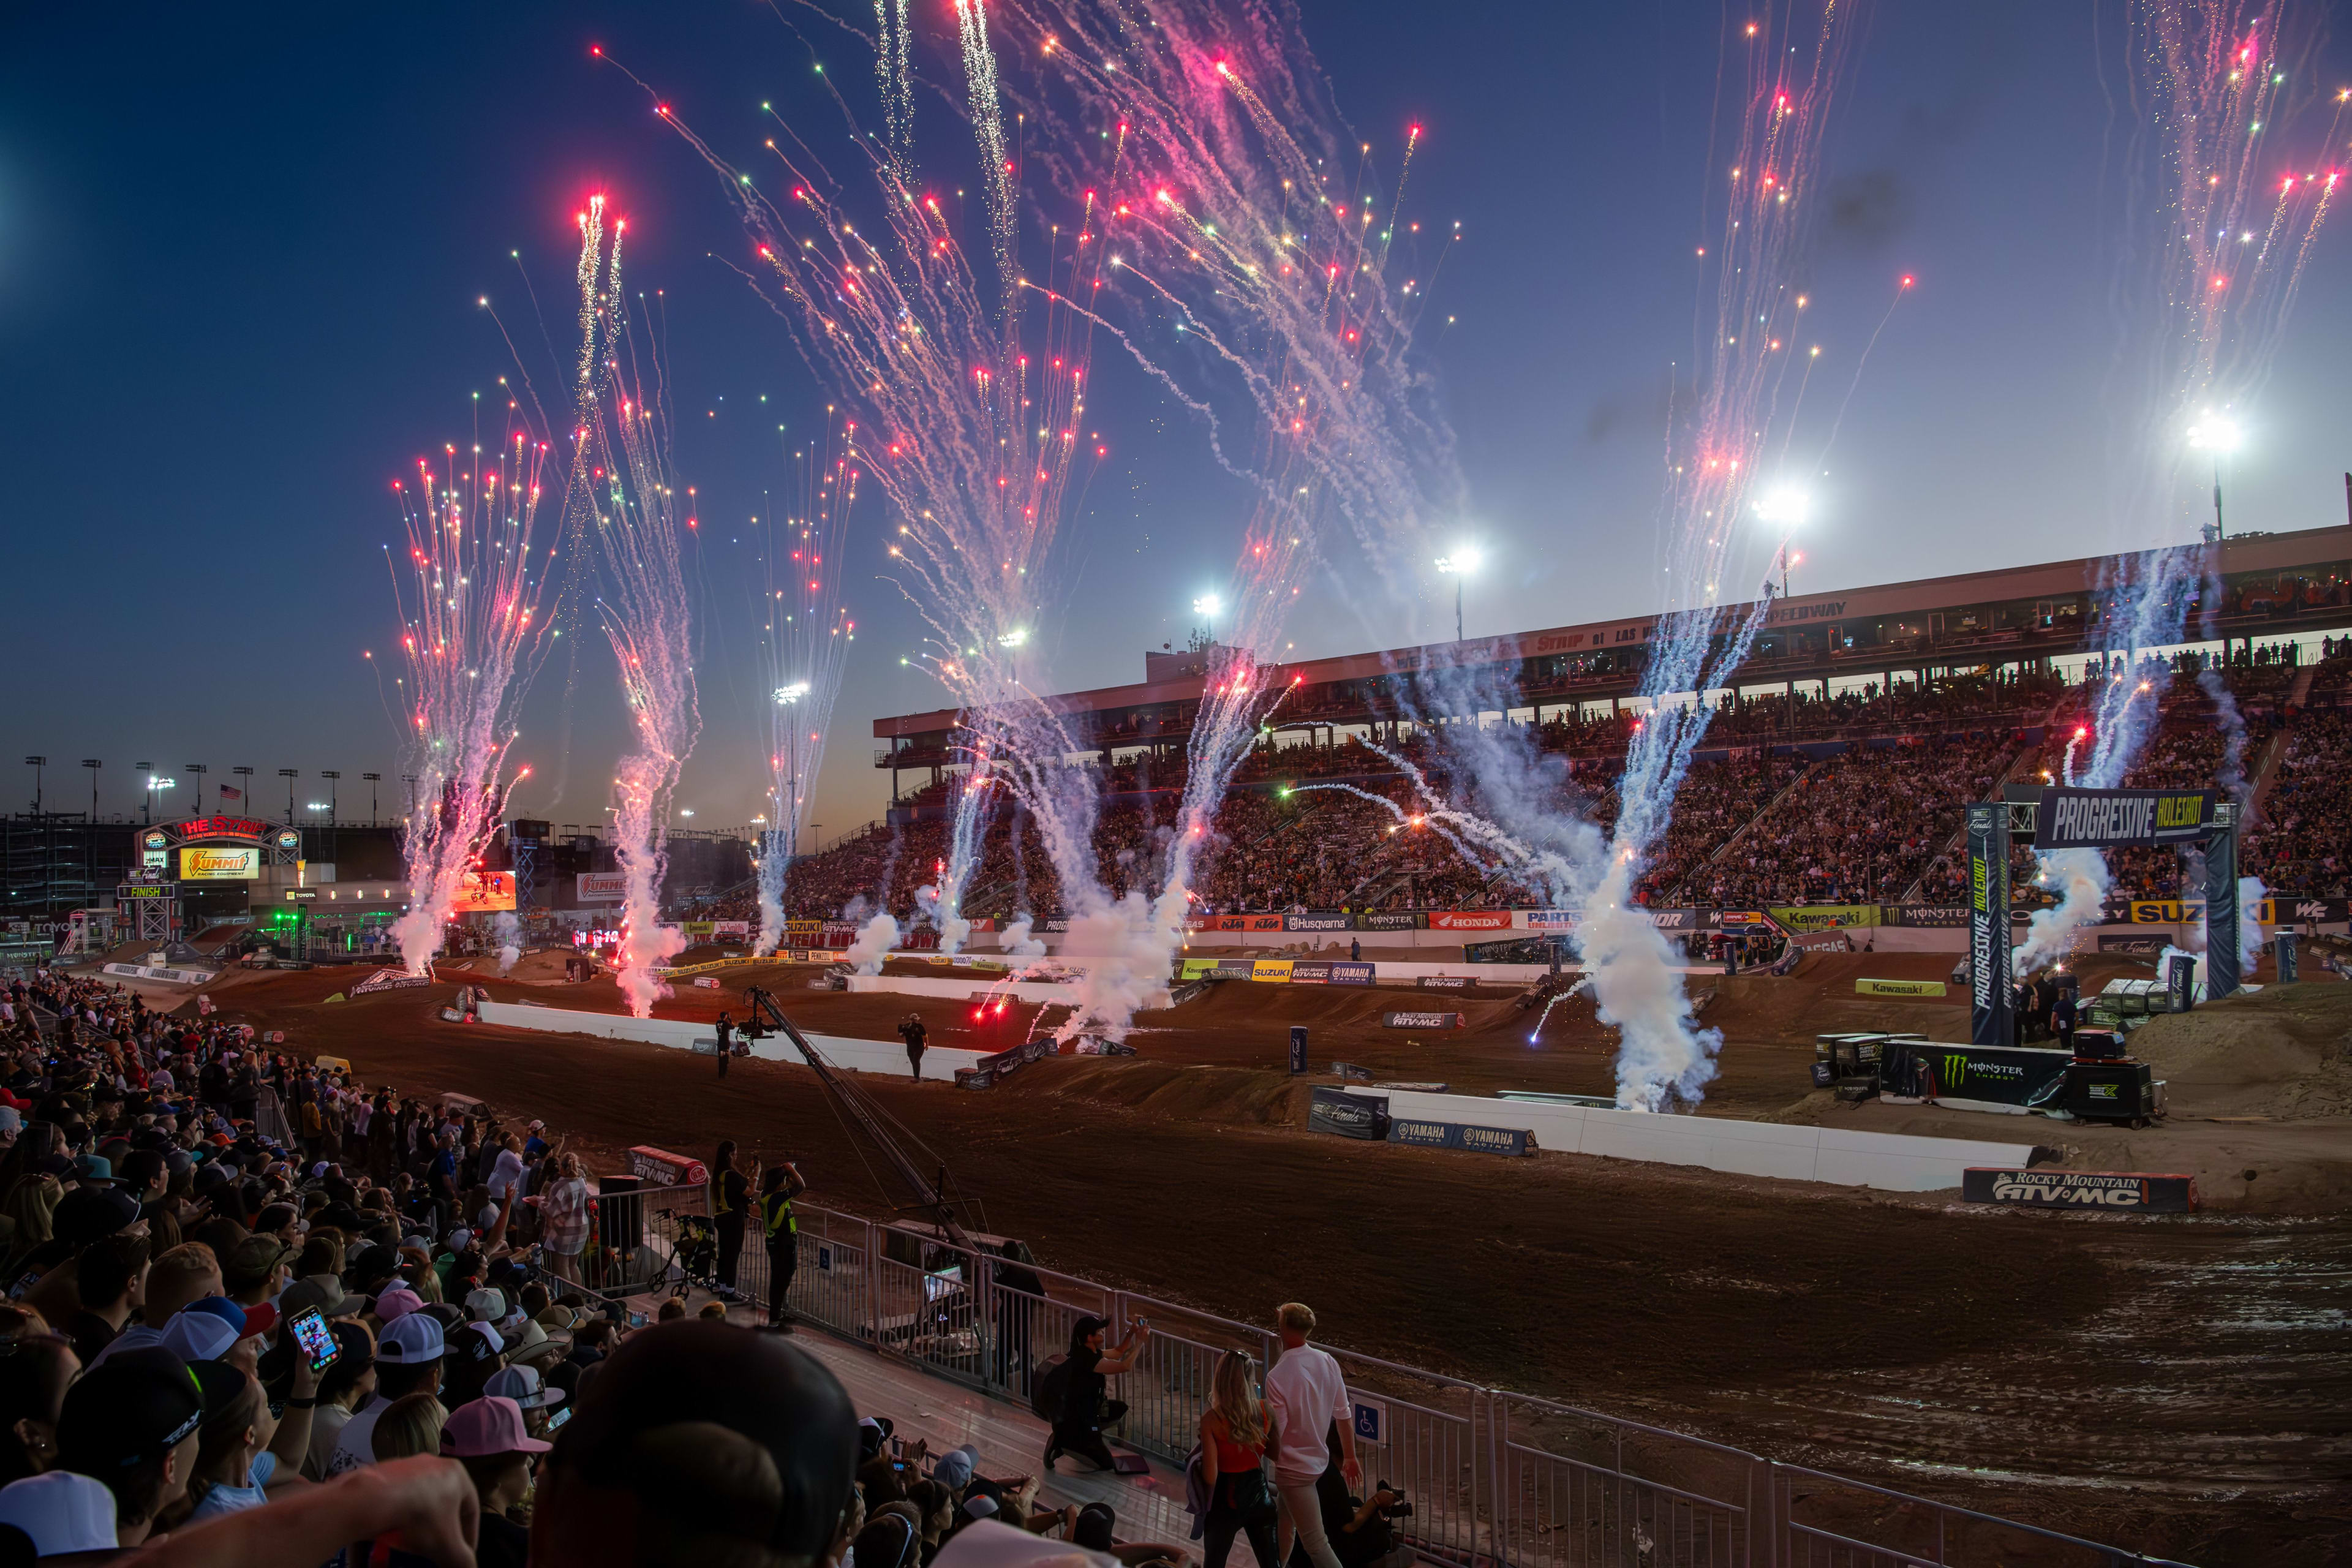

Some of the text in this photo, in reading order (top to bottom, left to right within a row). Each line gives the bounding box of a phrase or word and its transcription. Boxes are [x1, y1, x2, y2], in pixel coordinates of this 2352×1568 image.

[1615, 628, 1636, 642] LAS
[2052, 795, 2204, 841] PROGRESSIVE HOLESHOT
[178, 816, 267, 835] THE STRIP
[581, 875, 625, 897] SUMMI
[1973, 856, 1986, 911] HOLESHOT
[131, 888, 160, 897] FINISH
[1370, 914, 1412, 925] MONSTER
[1528, 912, 1583, 922] PARTS
[1789, 911, 1860, 924] Kawasaki
[786, 922, 820, 932] SUZUKI
[971, 919, 988, 929] LY
[1221, 919, 1245, 929] KTM
[1254, 918, 1279, 929] KTM
[1298, 919, 1345, 930] Husqvarna
[811, 952, 830, 960] PENNZOIL
[1975, 913, 1990, 1009] PROGRESSIVE
[2001, 913, 2011, 1009] PROGRESSIVE
[1341, 968, 1369, 978] YAMAHA
[1872, 983, 1923, 994] Kawasaki
[1967, 1061, 2023, 1076] MONSTER
[1409, 1124, 1444, 1139] YAMAHA
[1475, 1129, 1513, 1145] YAMAHA
[1466, 1142, 1510, 1150] RACING
[2015, 1173, 2140, 1189] ROCKY MOUNTAIN
